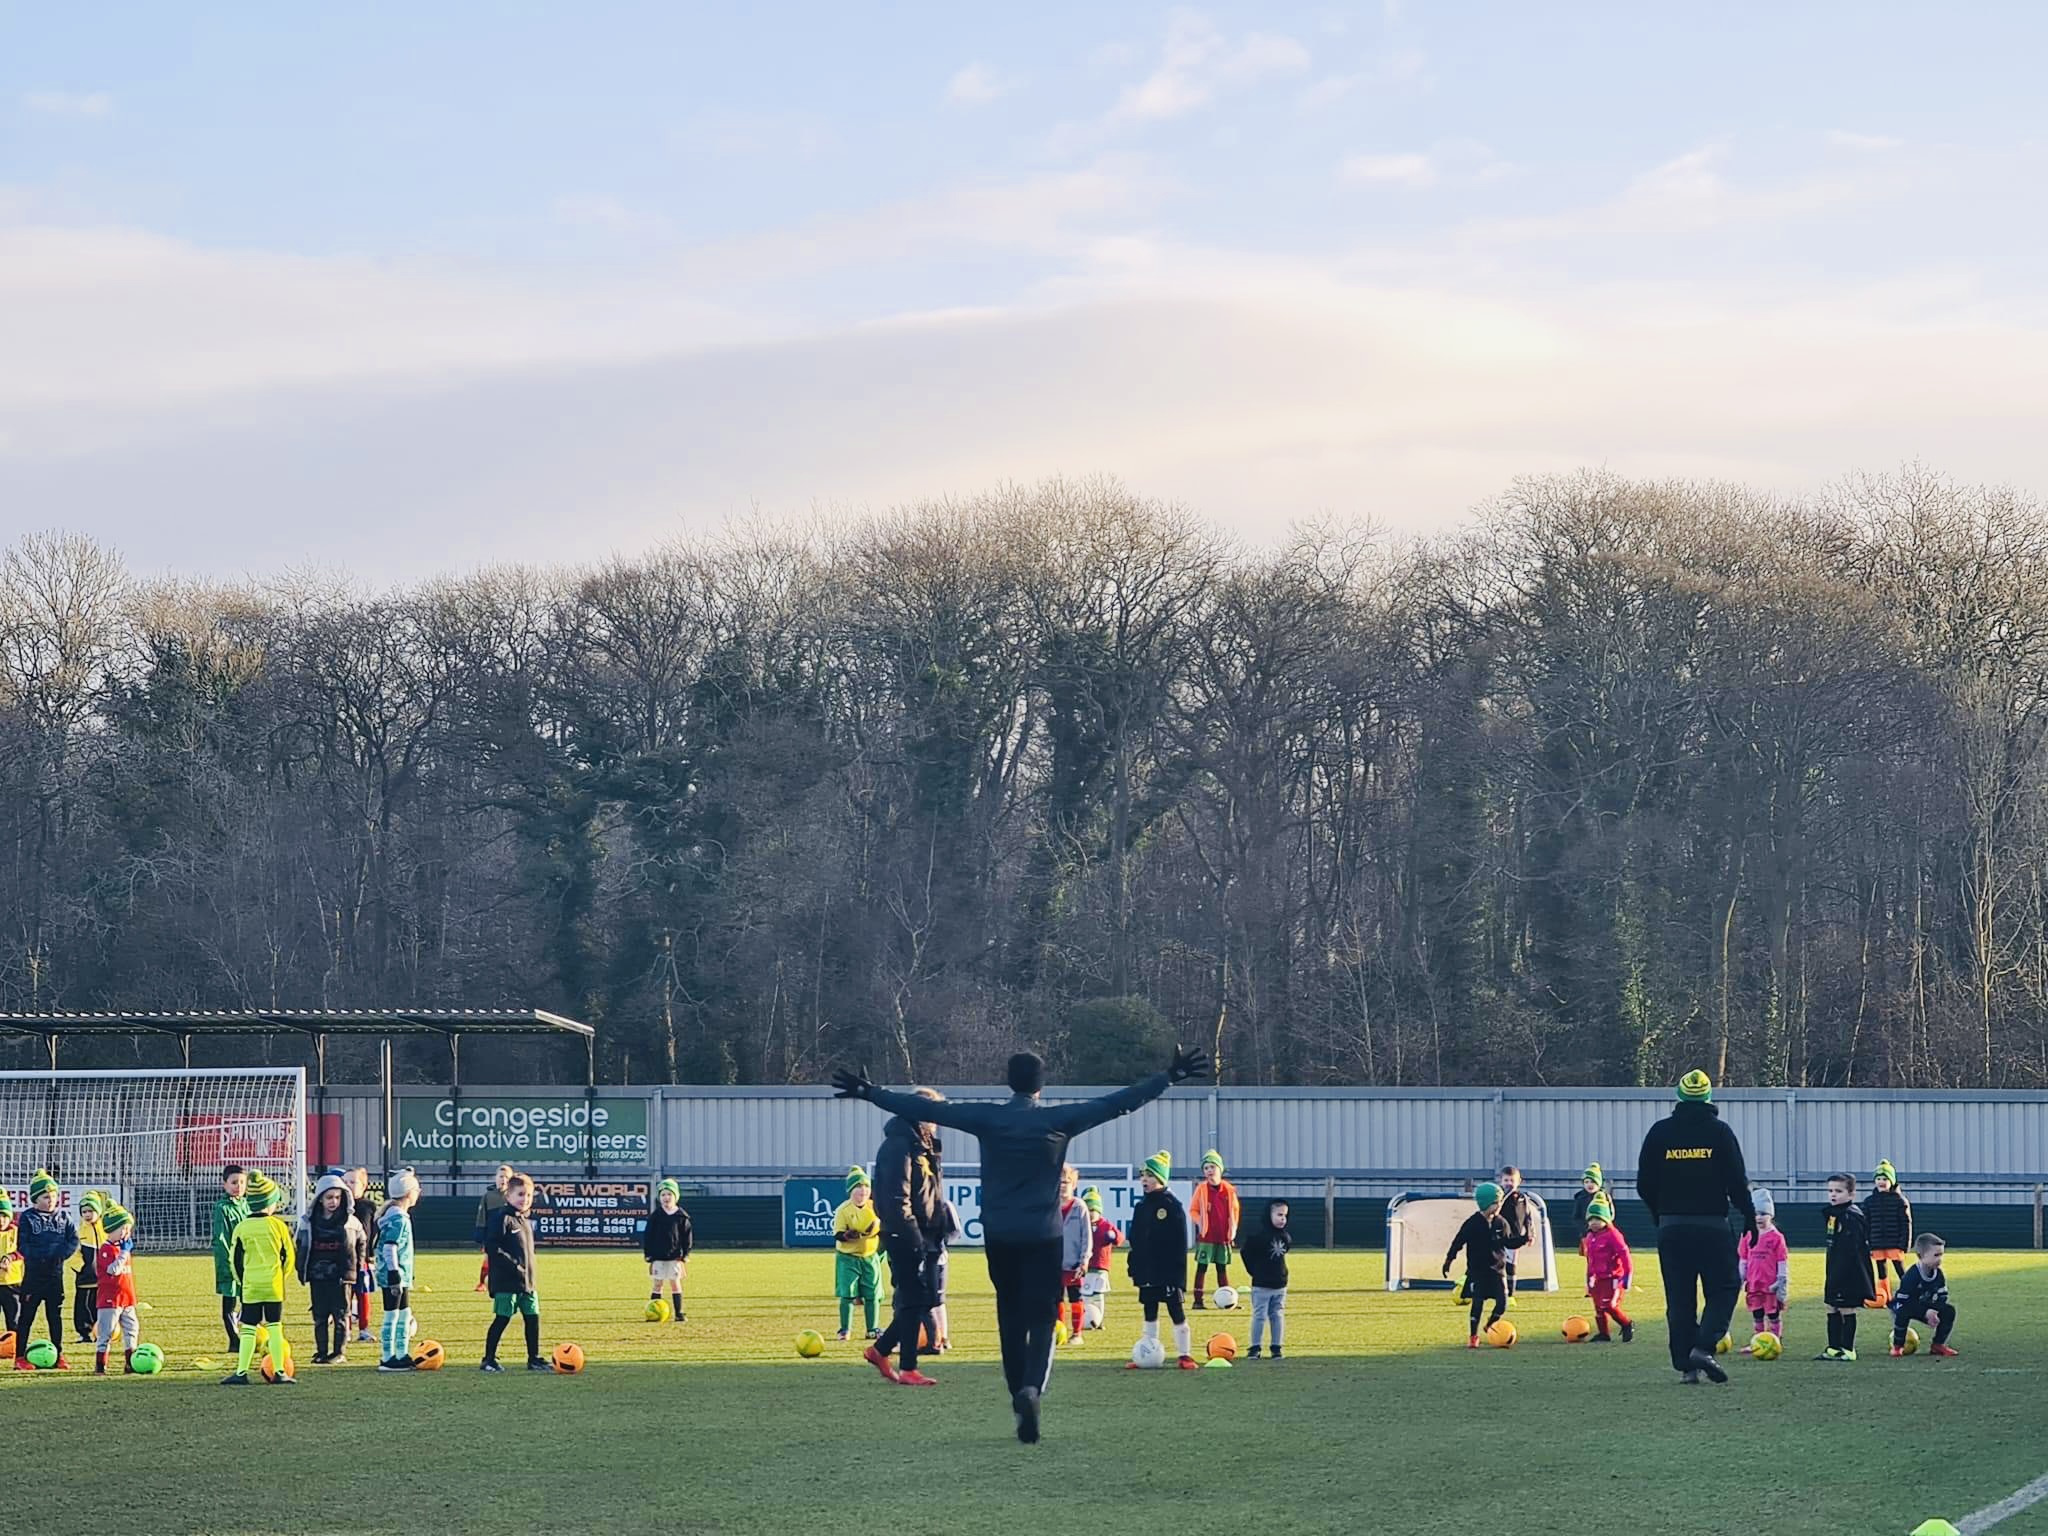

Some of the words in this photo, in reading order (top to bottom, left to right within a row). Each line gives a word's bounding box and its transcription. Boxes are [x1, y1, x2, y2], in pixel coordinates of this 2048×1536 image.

[435, 1100, 608, 1134] Grangeside
[402, 1128, 530, 1149] Automotive
[536, 1128, 648, 1154] Engineers
[580, 1184, 648, 1196] WORLD
[555, 1197, 618, 1208] WIDNES
[1109, 1187, 1145, 1208] TH
[540, 1217, 571, 1226] 0151
[575, 1217, 599, 1226] 424
[603, 1217, 635, 1226] 1448
[795, 1217, 834, 1230] HALT
[540, 1225, 571, 1234] 0151
[575, 1225, 599, 1234] 424
